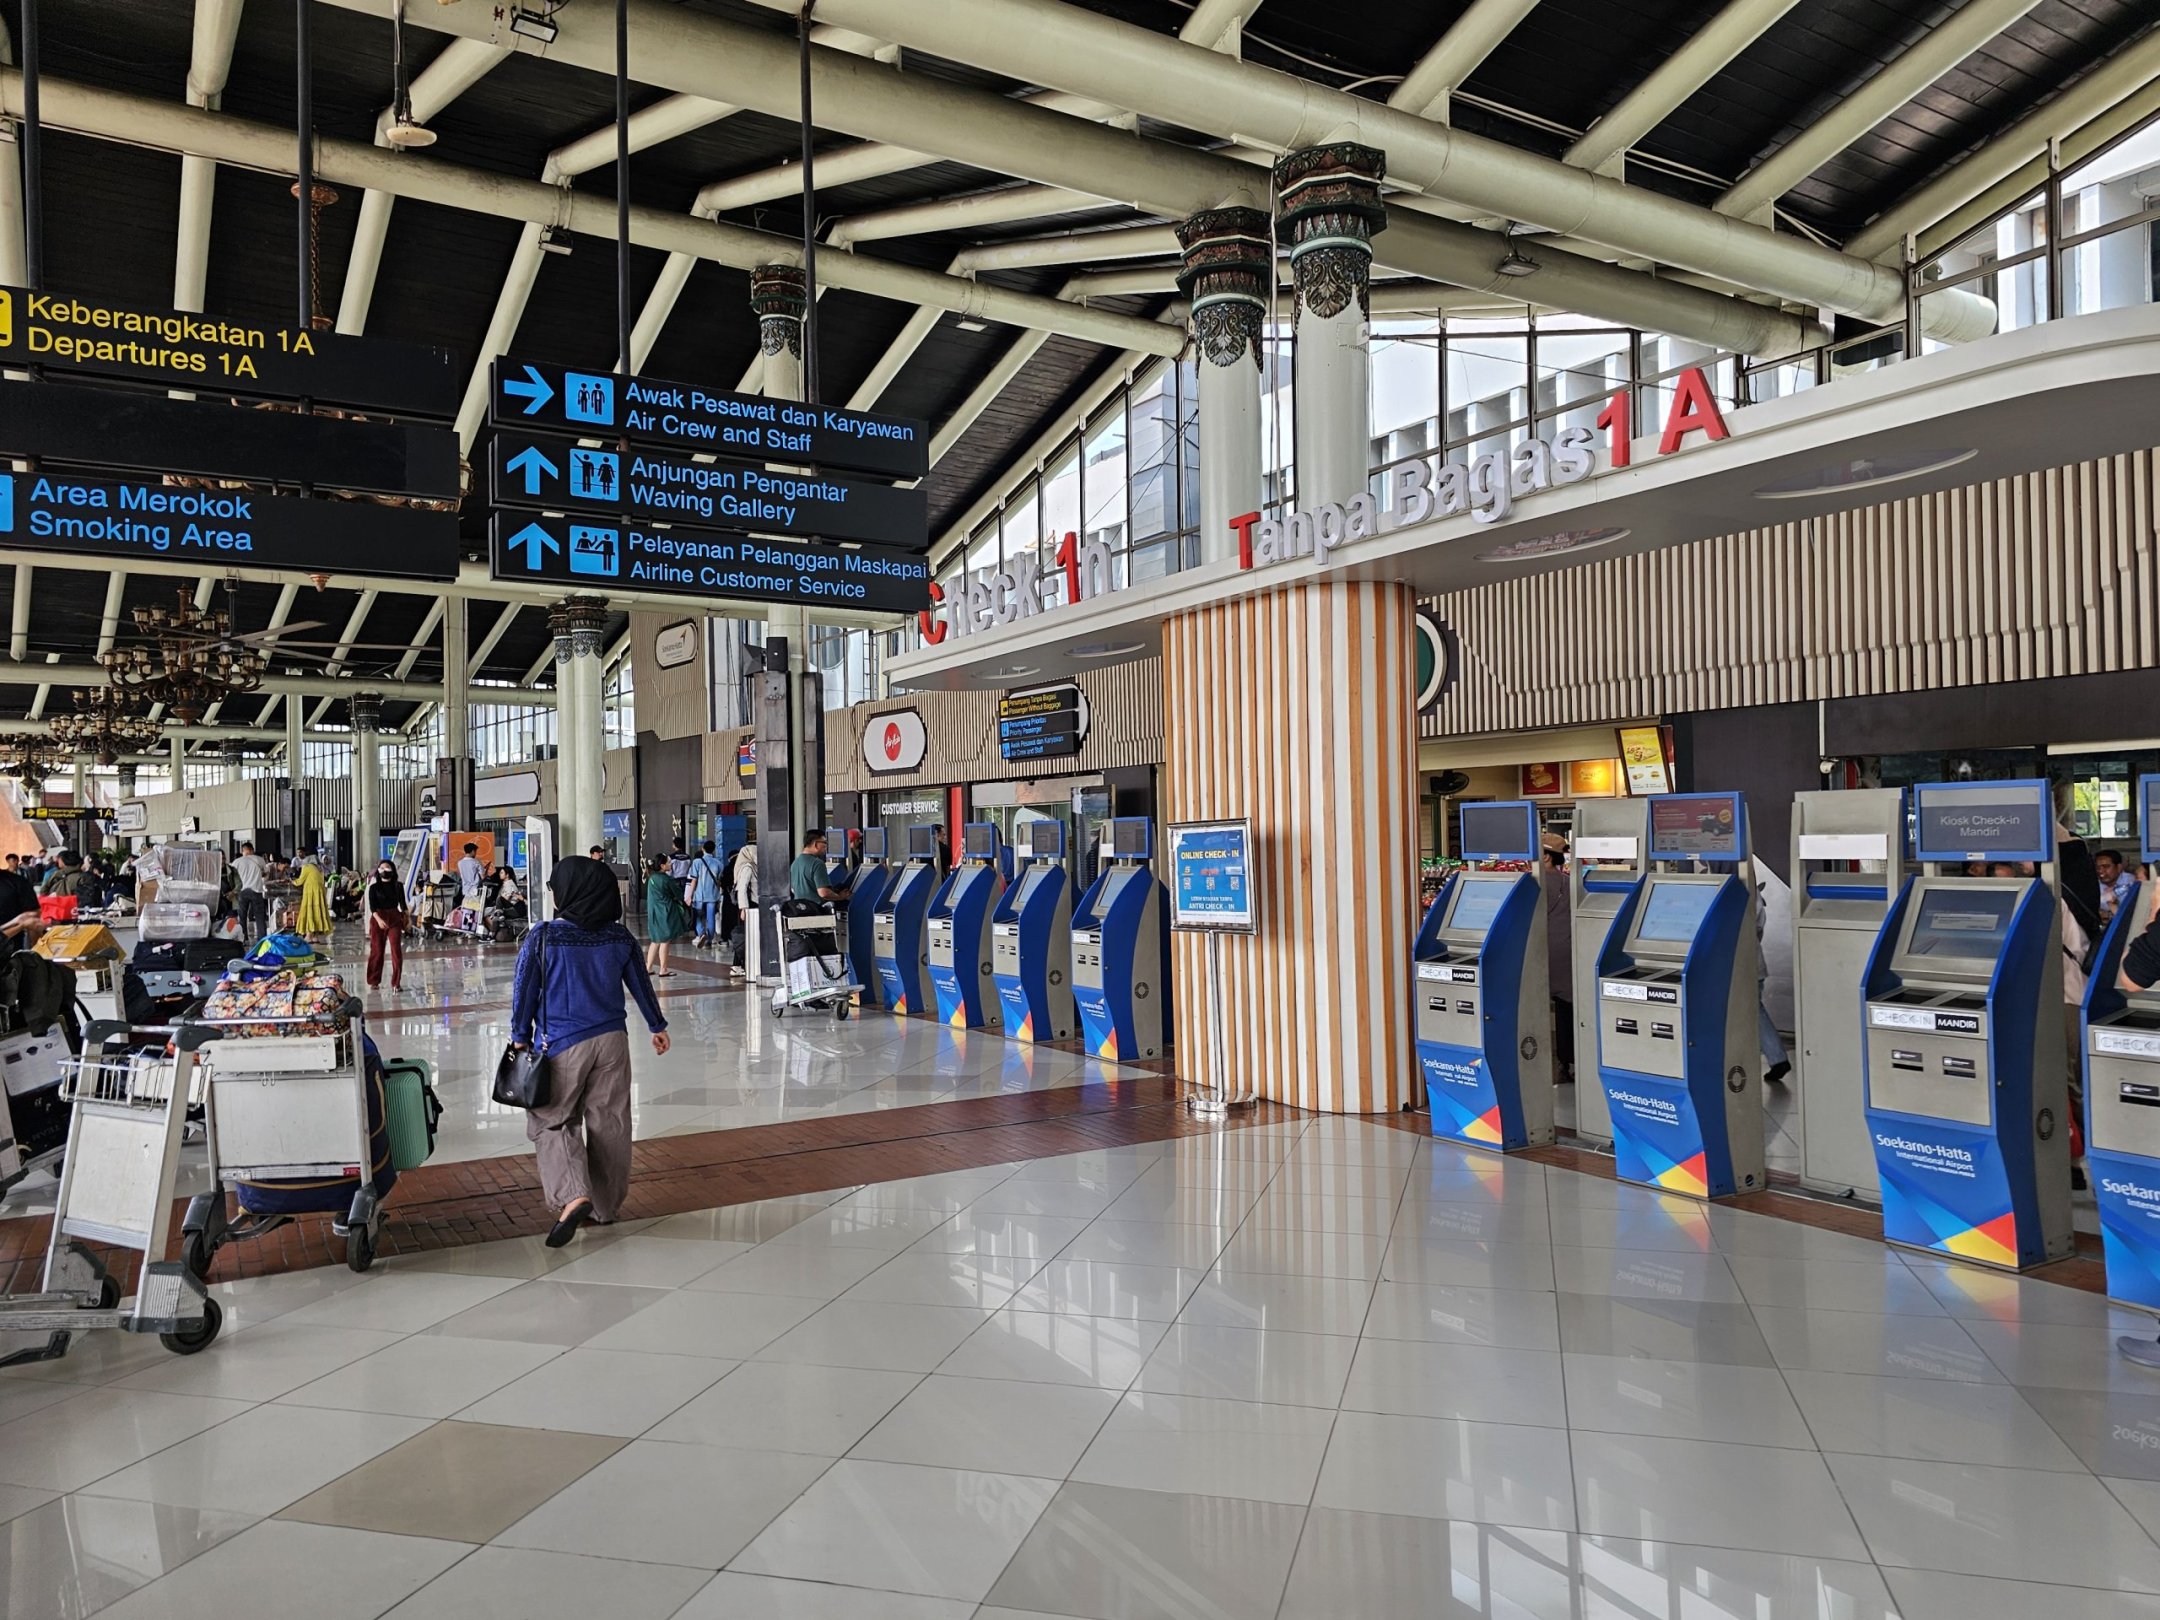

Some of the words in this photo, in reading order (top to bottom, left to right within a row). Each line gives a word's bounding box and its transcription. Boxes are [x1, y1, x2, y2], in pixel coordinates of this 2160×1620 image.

[27, 293, 265, 349] Keberangkatan
[276, 328, 315, 356] 1A
[28, 326, 206, 372] Departures
[218, 352, 258, 379] 1A
[626, 382, 684, 409] Awak
[691, 391, 777, 422] Pesawat
[781, 406, 817, 427] dan
[824, 411, 913, 442] Karyawan
[626, 410, 657, 431] Air
[662, 414, 717, 439] Crew
[722, 425, 760, 446] and
[766, 429, 811, 452] Staff
[631, 456, 734, 492] Anjungan
[744, 471, 848, 502] Pengantar
[30, 478, 108, 506] Area
[120, 486, 252, 520] Merokok
[631, 484, 714, 518] Waving
[720, 494, 796, 526] Gallery
[30, 511, 171, 551] Smoking
[180, 523, 253, 552] Area
[1229, 490, 1378, 571] Tanpa
[629, 532, 734, 560] Pelayanan
[740, 545, 839, 575] Pelanggan
[845, 554, 927, 582] Maskapai
[631, 560, 694, 583] Airline
[700, 568, 794, 593] Customer
[799, 576, 866, 598] Service
[97, 808, 113, 818] 1A
[882, 802, 912, 815] CUSTOMER
[913, 800, 938, 814] SERVICE
[1940, 816, 1970, 826] Kiosk
[1972, 816, 2020, 825] Check-in
[1960, 827, 2000, 837] Mandiri
[1181, 850, 1204, 860] ONLINE
[1205, 850, 1227, 859] CHECK
[1189, 902, 1204, 910] ANTRI
[1605, 984, 1646, 997] CHECK-IN
[1648, 990, 1676, 1000] MANDIRI
[1875, 1011, 1931, 1025] CHECK-IN
[1937, 1018, 1976, 1029] MANDIRI
[1423, 1058, 1475, 1075] Soekarno-Hatta
[1608, 1088, 1676, 1112] Soekarno-Hatta
[1876, 1134, 1972, 1162] Soekarno-Hatta
[1895, 1150, 1944, 1165] International
[1945, 1160, 1974, 1171] Airport
